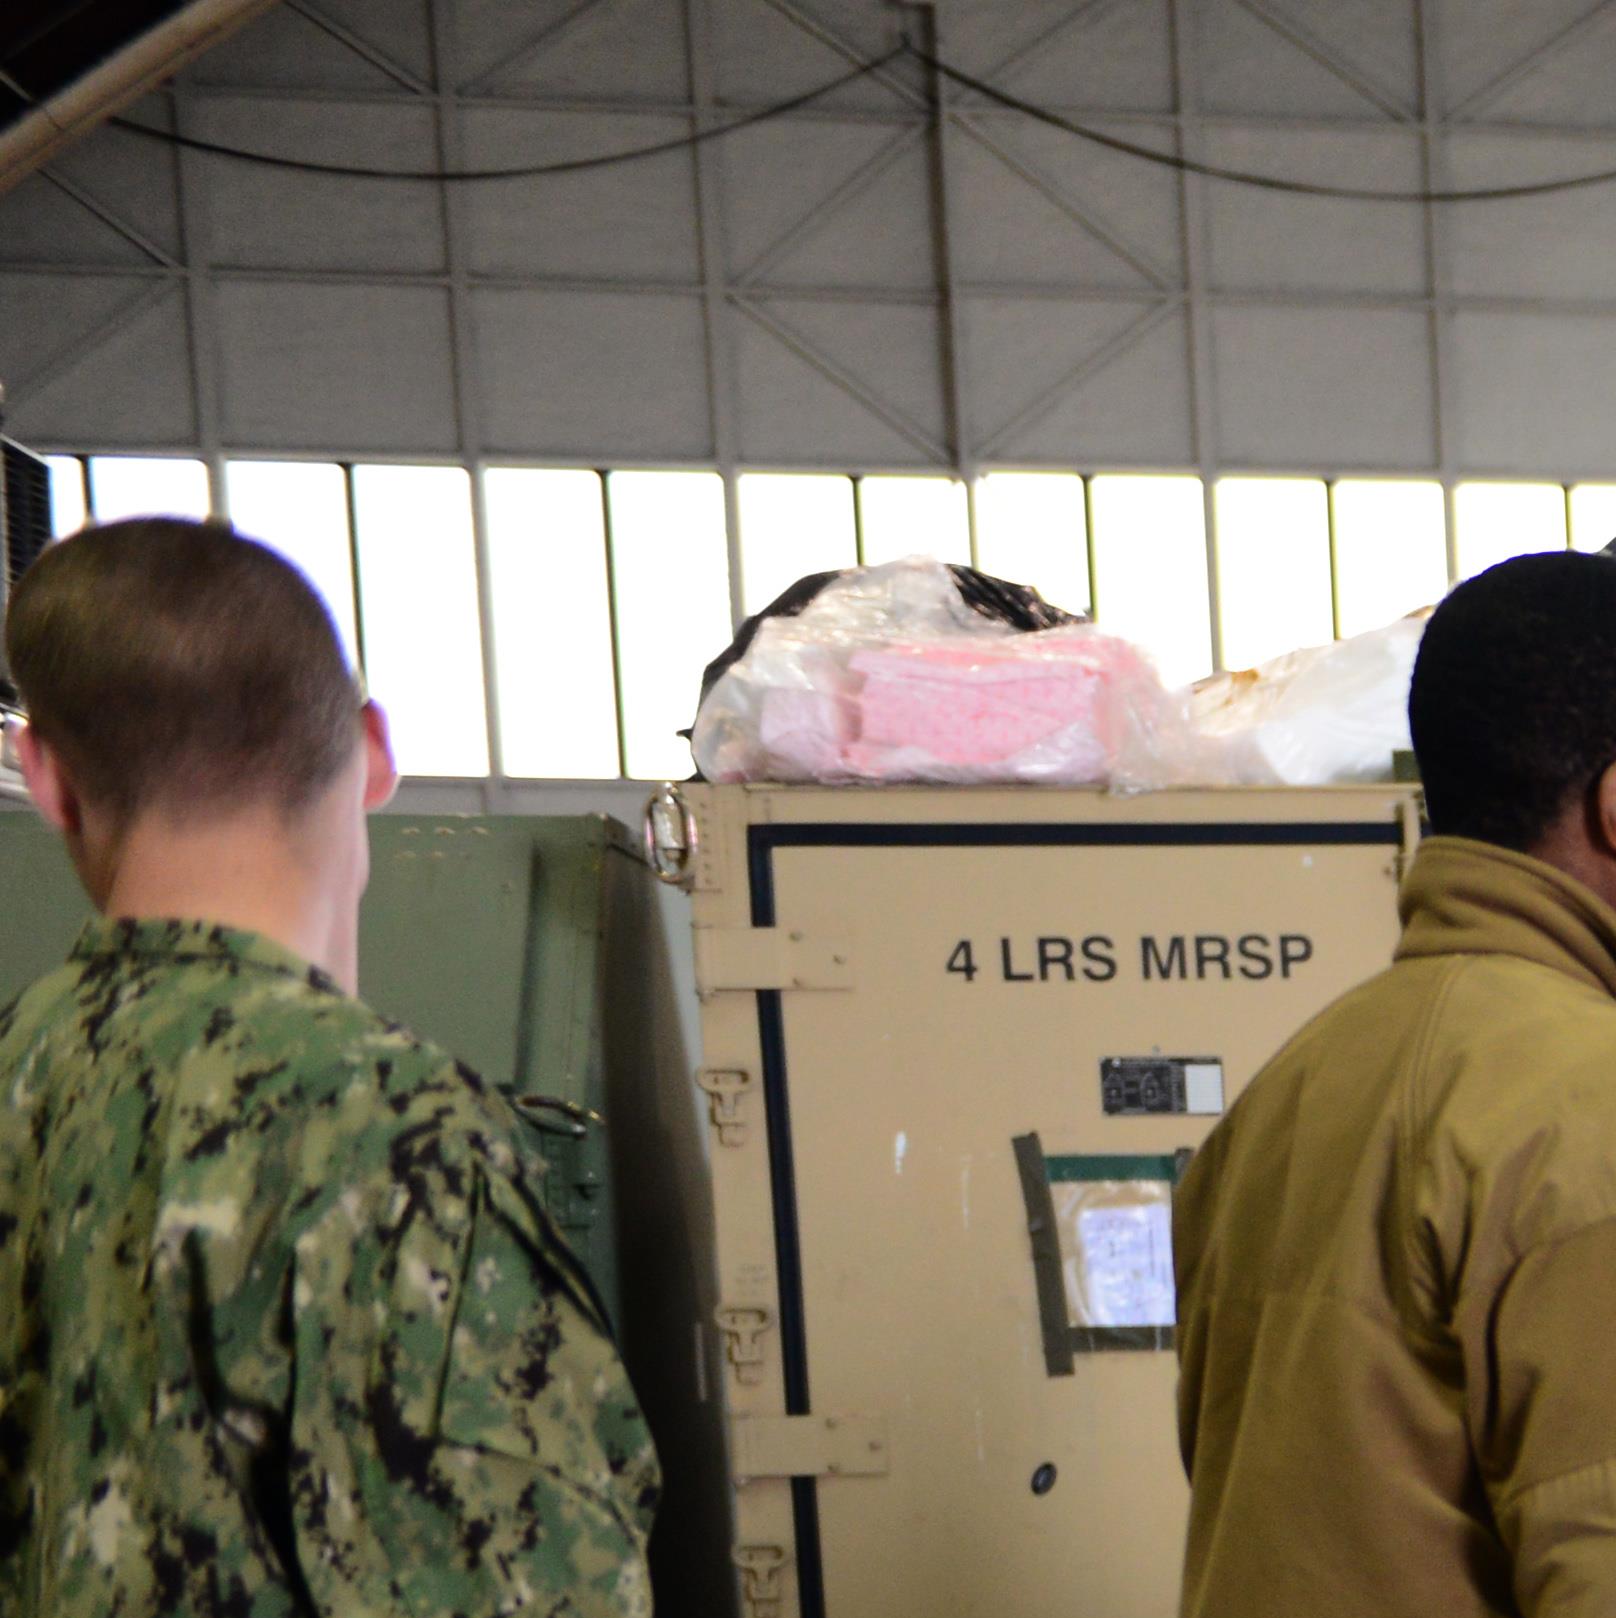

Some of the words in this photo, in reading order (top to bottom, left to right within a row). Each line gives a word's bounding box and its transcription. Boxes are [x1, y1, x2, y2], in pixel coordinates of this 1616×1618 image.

[946, 938, 978, 982] 4
[1001, 936, 1118, 982] LRS
[1141, 934, 1313, 980] MRSP
